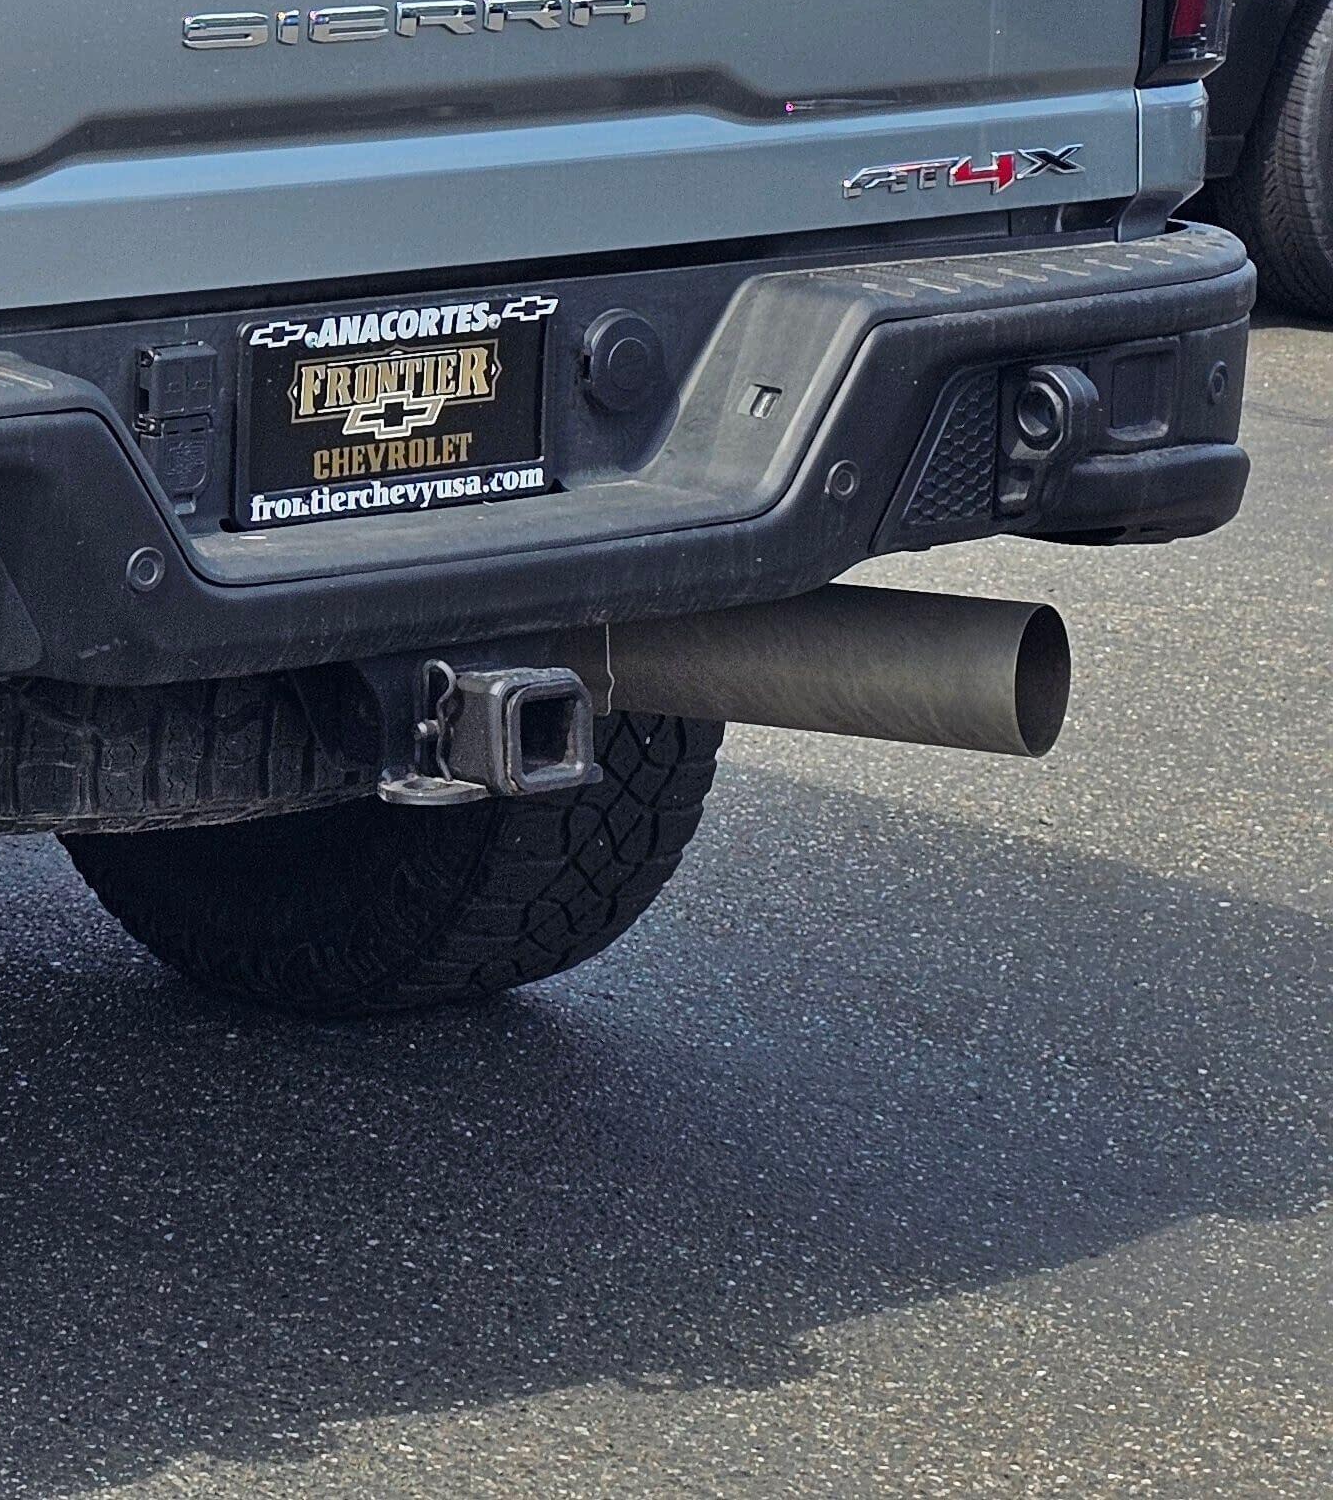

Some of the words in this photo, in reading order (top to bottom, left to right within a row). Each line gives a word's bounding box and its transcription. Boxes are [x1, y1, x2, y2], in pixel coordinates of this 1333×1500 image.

[843, 143, 1086, 199] AT4X
[317, 302, 491, 348] ANACORTES
[298, 346, 492, 416] FRONTIER
[312, 431, 473, 481] CHEVROLET
[249, 466, 545, 522] frontierchevyusa.com
